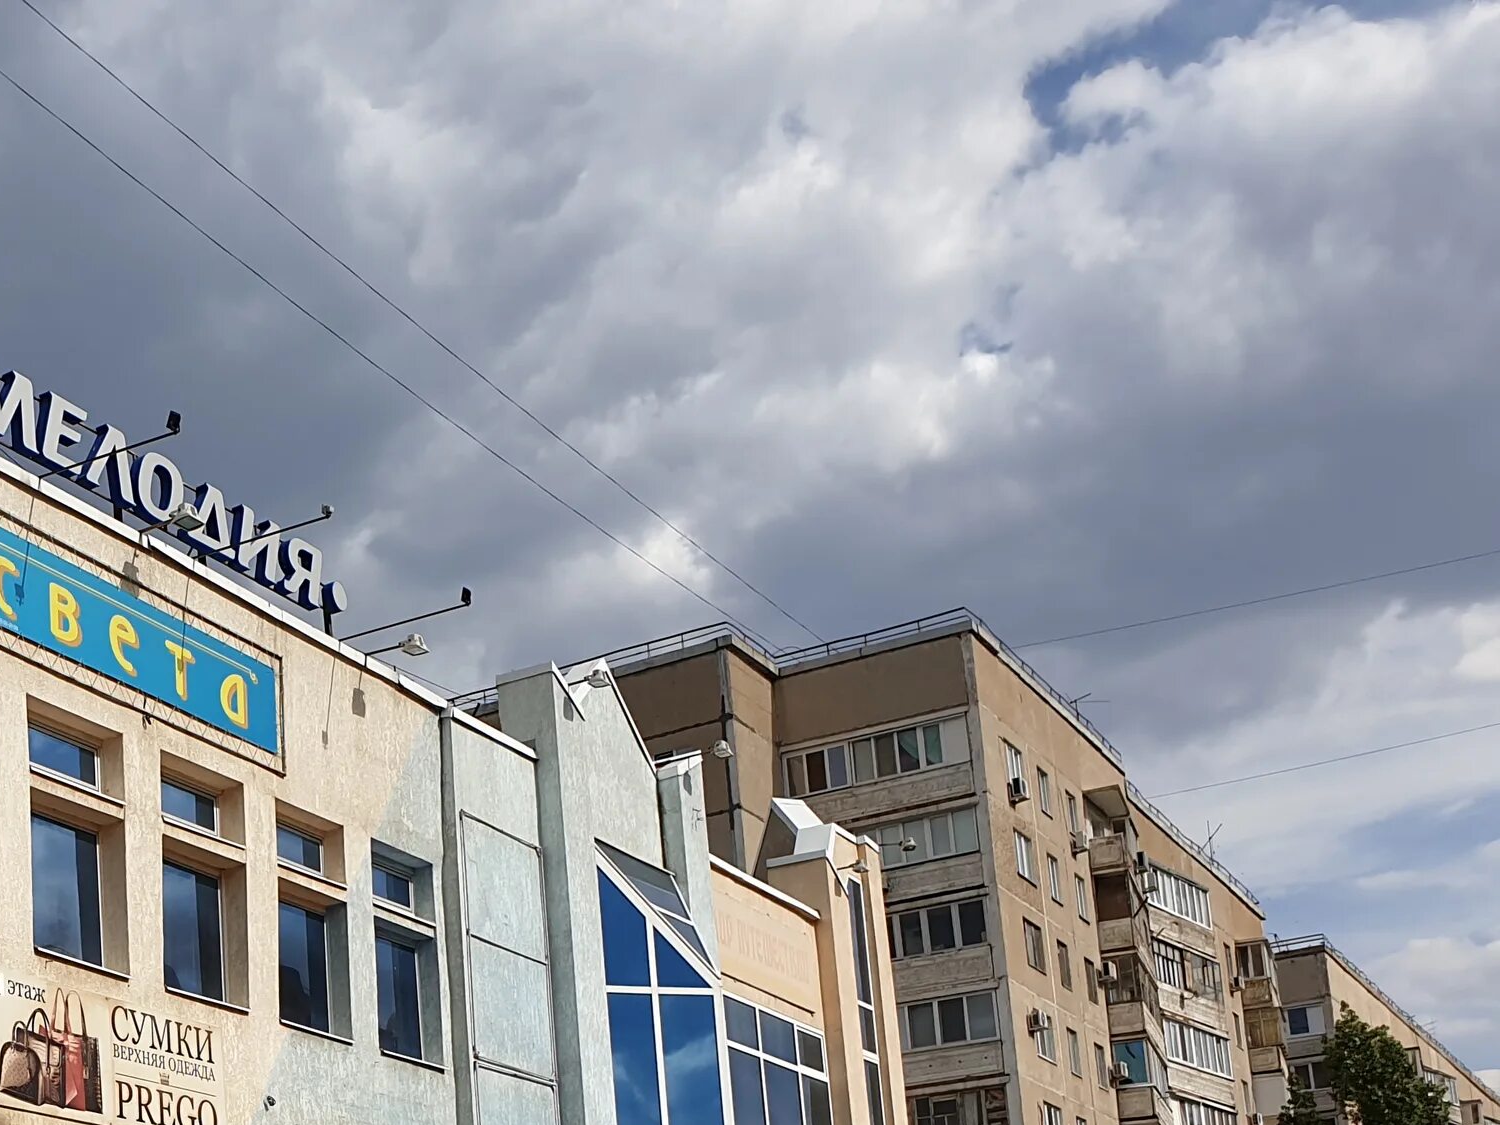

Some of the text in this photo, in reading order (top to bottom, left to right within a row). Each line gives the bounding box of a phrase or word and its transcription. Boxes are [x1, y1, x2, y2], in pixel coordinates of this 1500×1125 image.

[7, 980, 46, 1003] этаж
[112, 1005, 215, 1064] СУМКИ
[113, 1043, 216, 1082] ВЕРХНЯЯ ОДЕЖДА
